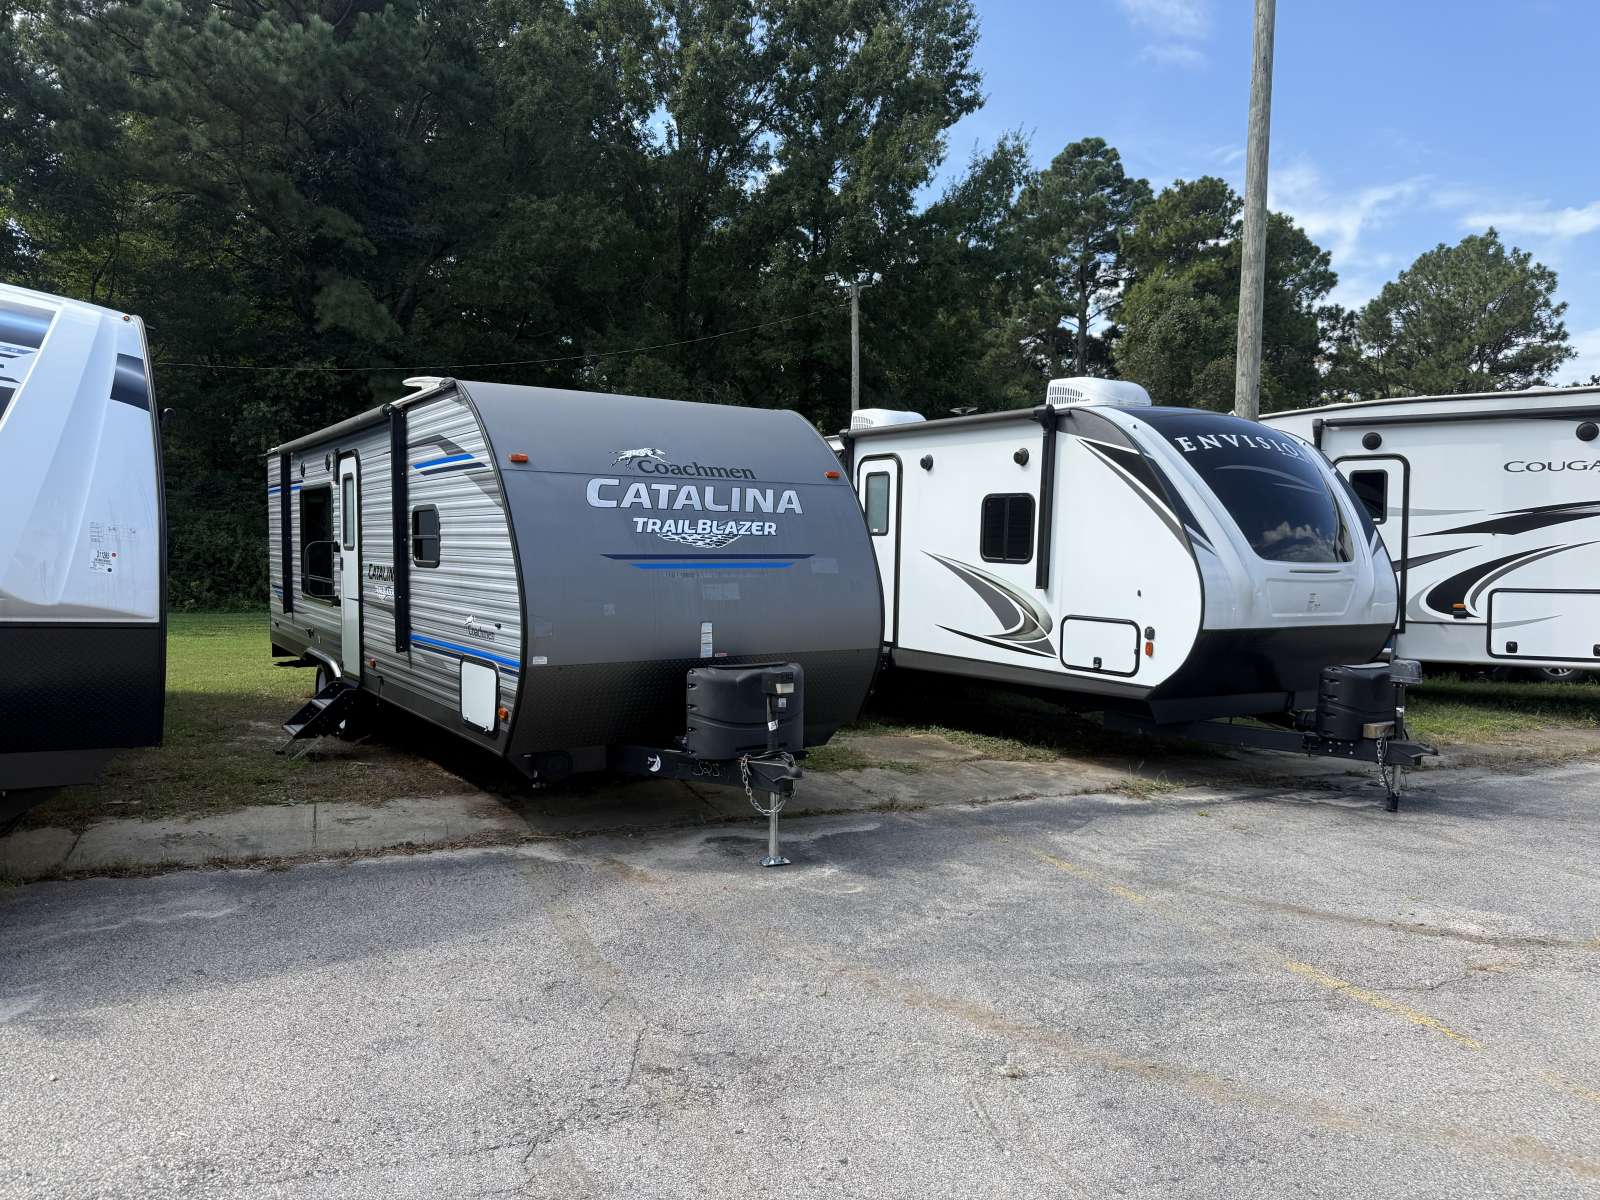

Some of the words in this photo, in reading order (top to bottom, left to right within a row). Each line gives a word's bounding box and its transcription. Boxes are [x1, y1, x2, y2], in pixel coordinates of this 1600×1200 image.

[637, 459, 757, 480] Coachmen
[586, 478, 803, 515] CATALINA
[632, 517, 777, 536] TRAILBLAZER
[368, 563, 395, 582] CATALIN
